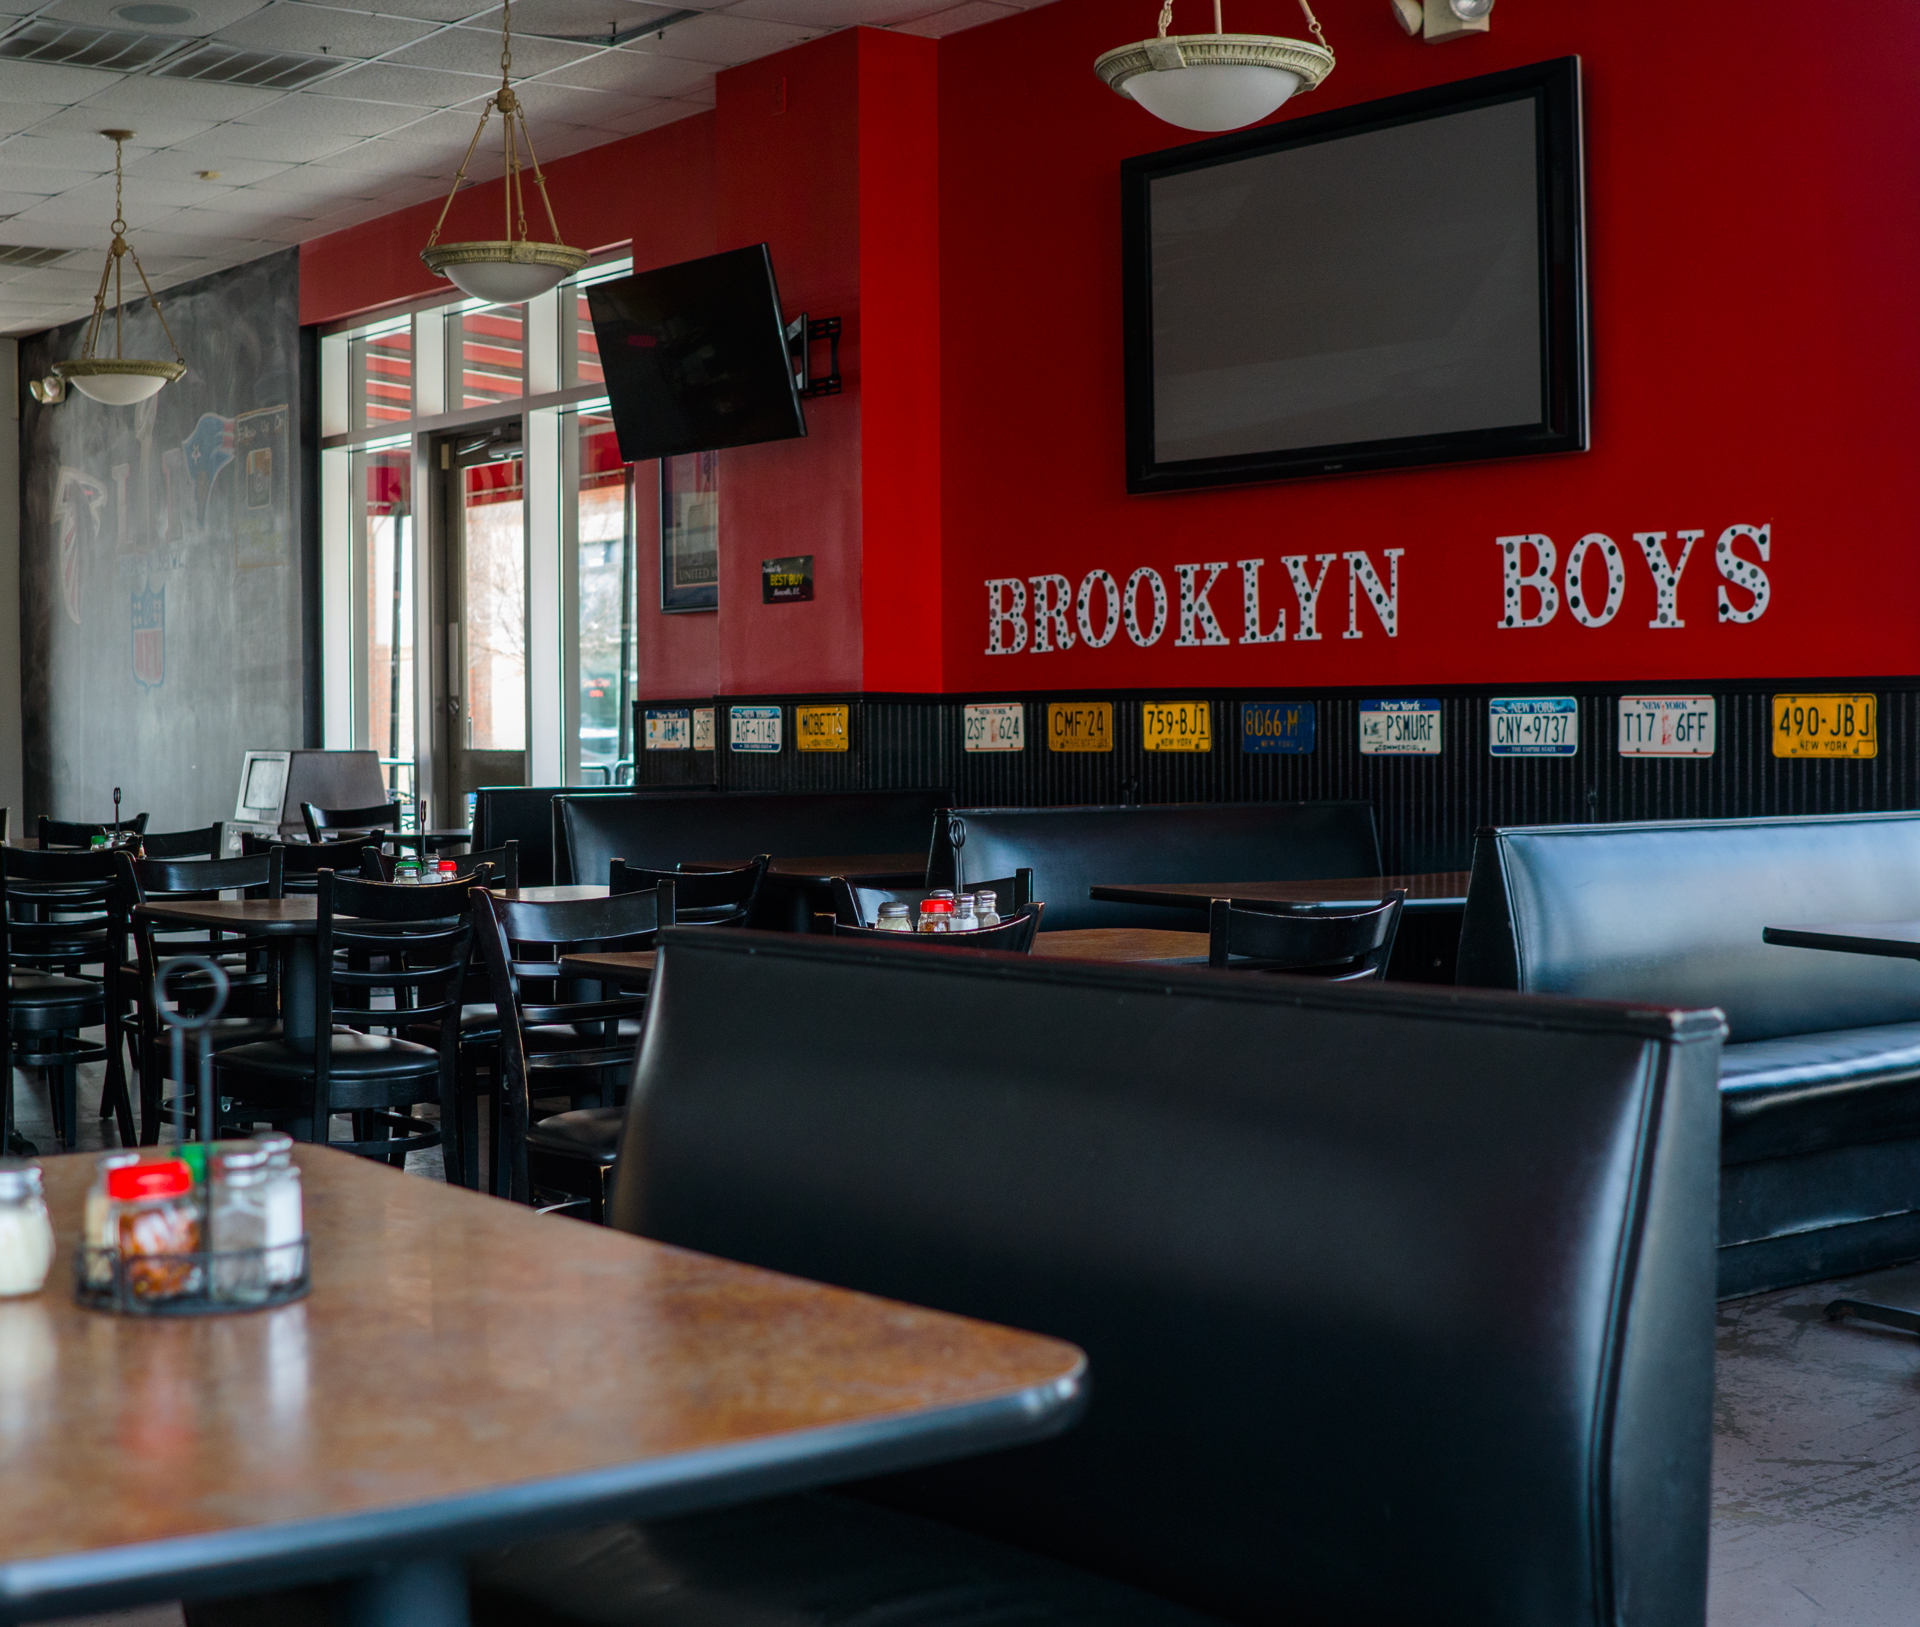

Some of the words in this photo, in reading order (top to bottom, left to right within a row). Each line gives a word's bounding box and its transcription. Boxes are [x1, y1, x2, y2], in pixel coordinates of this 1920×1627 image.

[680, 568, 709, 580] UNITED
[770, 574, 788, 586] BEST
[788, 573, 804, 586] BUY
[984, 548, 1405, 656] BROOKLYN
[1496, 523, 1771, 629] BOYS
[1381, 701, 1399, 711] New
[1400, 700, 1421, 711] York
[1511, 702, 1530, 712] NEW
[1533, 702, 1556, 712] YORK
[1642, 701, 1661, 710] NEW
[1665, 701, 1688, 710] YORK
[967, 717, 987, 740] 2SF
[999, 716, 1020, 740] 624
[1624, 713, 1656, 742] T17
[1676, 712, 1708, 742] 6FF
[1161, 738, 1174, 747] NEW
[1177, 738, 1193, 747] YORK
[1800, 741, 1820, 751] NEW
[1824, 741, 1848, 751] YORK
